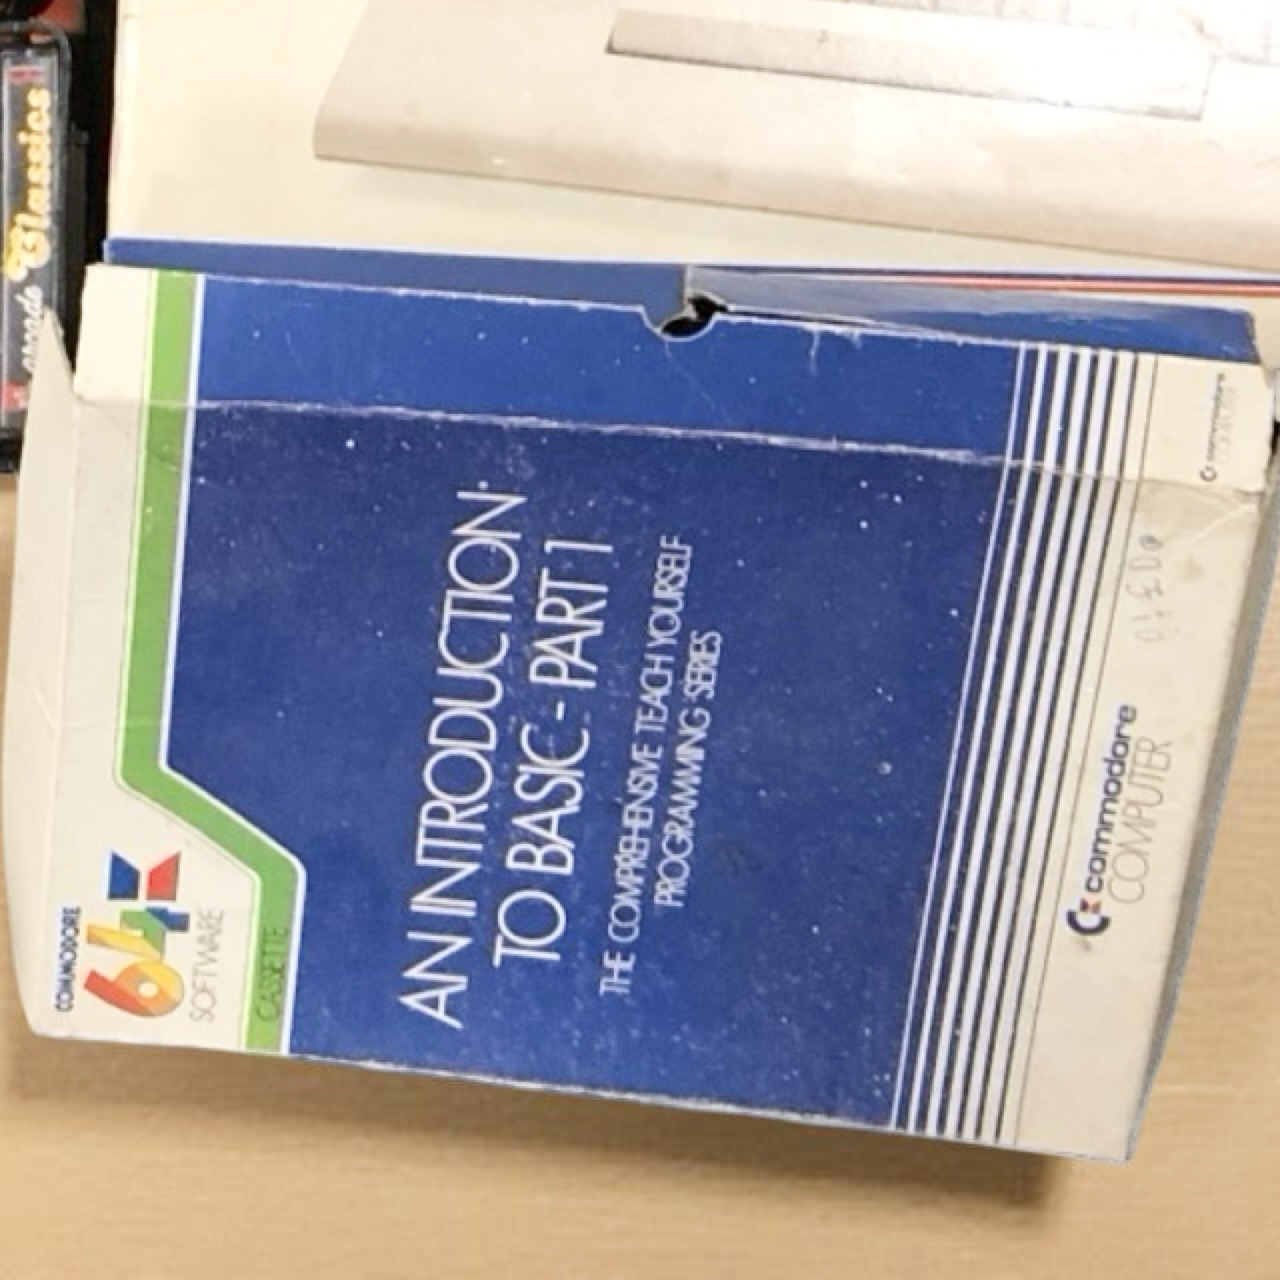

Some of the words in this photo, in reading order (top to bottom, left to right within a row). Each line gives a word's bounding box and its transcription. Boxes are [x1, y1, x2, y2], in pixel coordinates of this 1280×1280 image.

[0, 86, 51, 282] Classics
[543, 539, 614, 554] 1
[645, 533, 694, 648] YOURSELF
[528, 566, 610, 689] PART
[633, 653, 675, 735] TEACH
[505, 722, 591, 876] BASIC
[652, 708, 712, 908] PROGRAMMING
[683, 629, 723, 700] SERIES
[1083, 703, 1138, 895] commodore
[1108, 734, 1174, 905] COMPUTER
[606, 741, 664, 943] COMPREHENSIVE
[55, 906, 81, 1013] COMMODORE
[84, 906, 190, 1019] 64
[189, 906, 225, 1023] SOFTWARE
[256, 926, 290, 1023] CASSETTE
[397, 930, 474, 1031] AN
[492, 888, 567, 968] TO
[598, 949, 637, 997] THE
